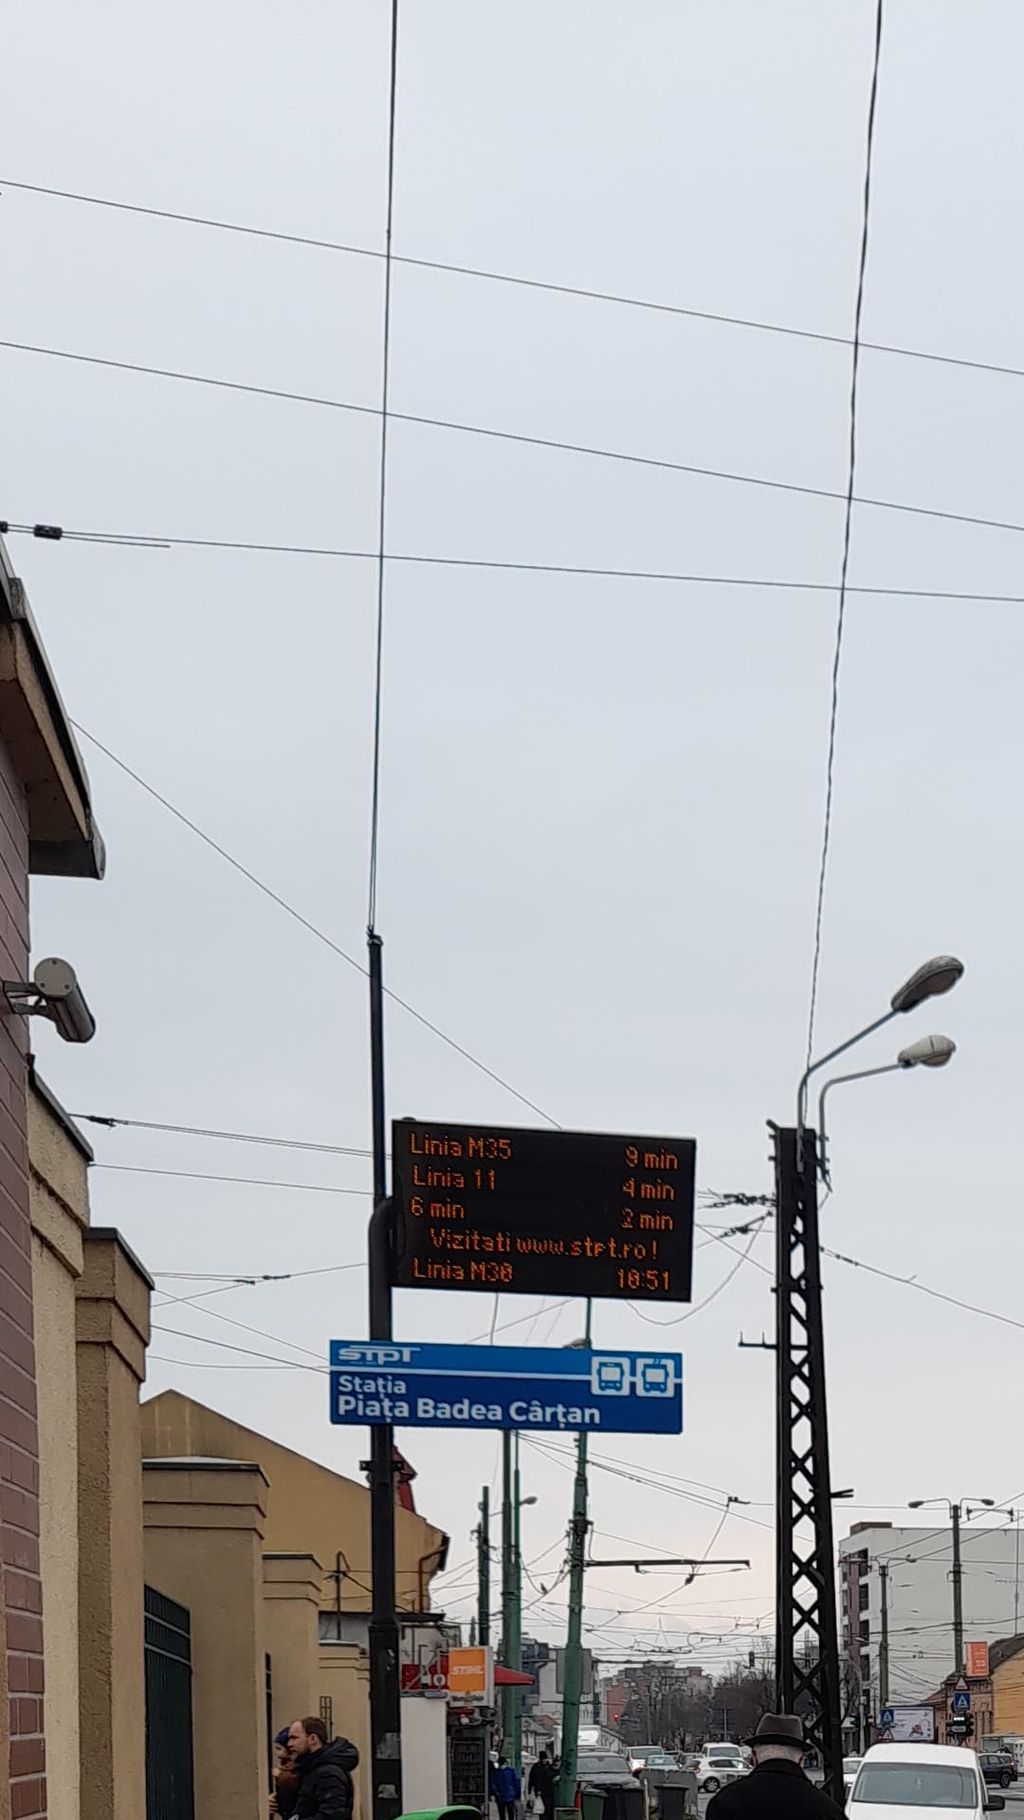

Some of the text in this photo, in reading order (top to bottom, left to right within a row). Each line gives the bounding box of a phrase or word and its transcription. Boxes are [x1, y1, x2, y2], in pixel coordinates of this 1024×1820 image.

[410, 1132, 678, 1170] Linia M35 9 min
[413, 1164, 675, 1201] Linia 11 4 min
[410, 1196, 673, 1231] 6 min 2 min
[430, 1227, 510, 1253] Vizitati
[412, 1257, 670, 1291] Linia M30 10:51
[338, 1375, 407, 1399] Stația
[337, 1395, 601, 1429] Piața Badea Cârțan
